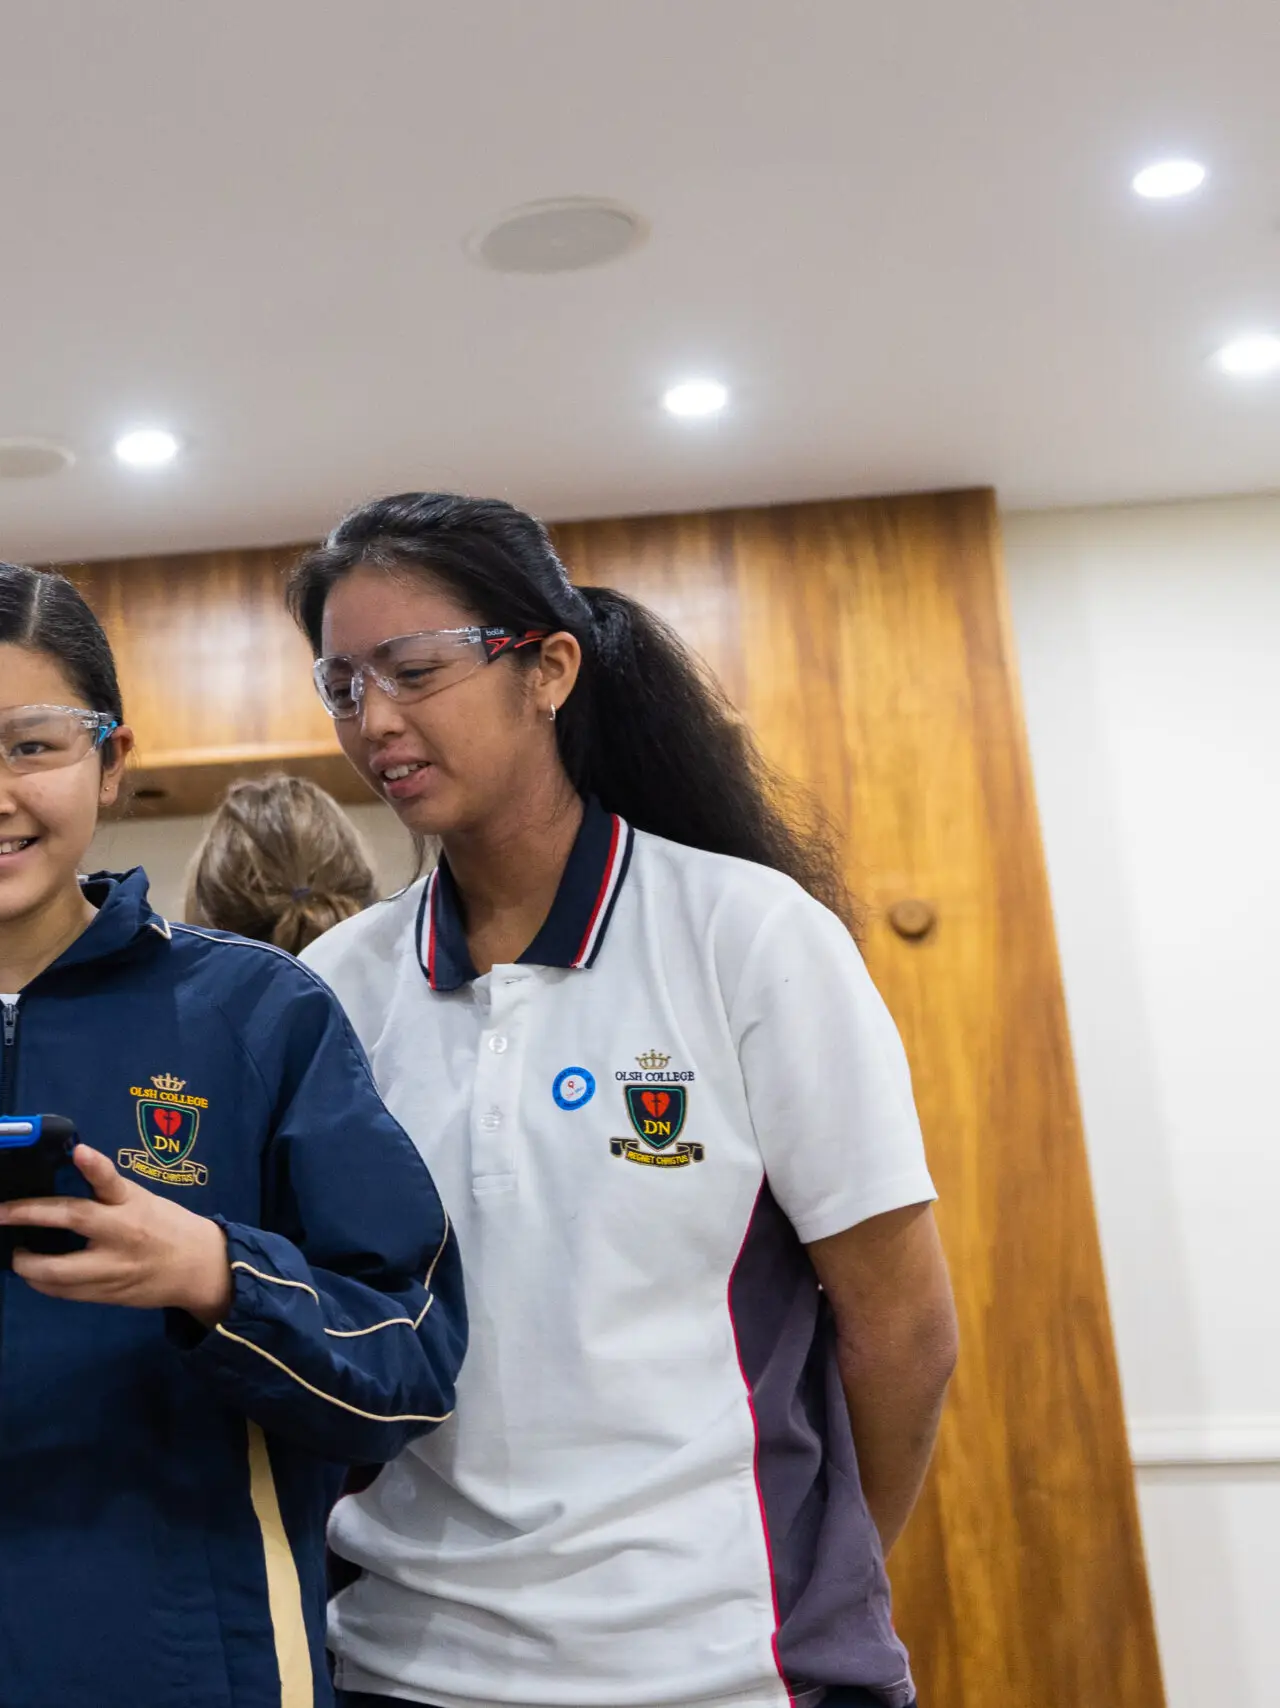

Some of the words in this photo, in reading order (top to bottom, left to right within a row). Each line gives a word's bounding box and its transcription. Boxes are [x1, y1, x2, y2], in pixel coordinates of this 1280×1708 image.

[615, 1071, 643, 1082] OLSH
[645, 1071, 695, 1082] COLLEGE
[129, 1086, 157, 1099] OLSH
[160, 1092, 209, 1109] COLLEGE
[643, 1119, 671, 1136] DN
[153, 1135, 181, 1153] DN
